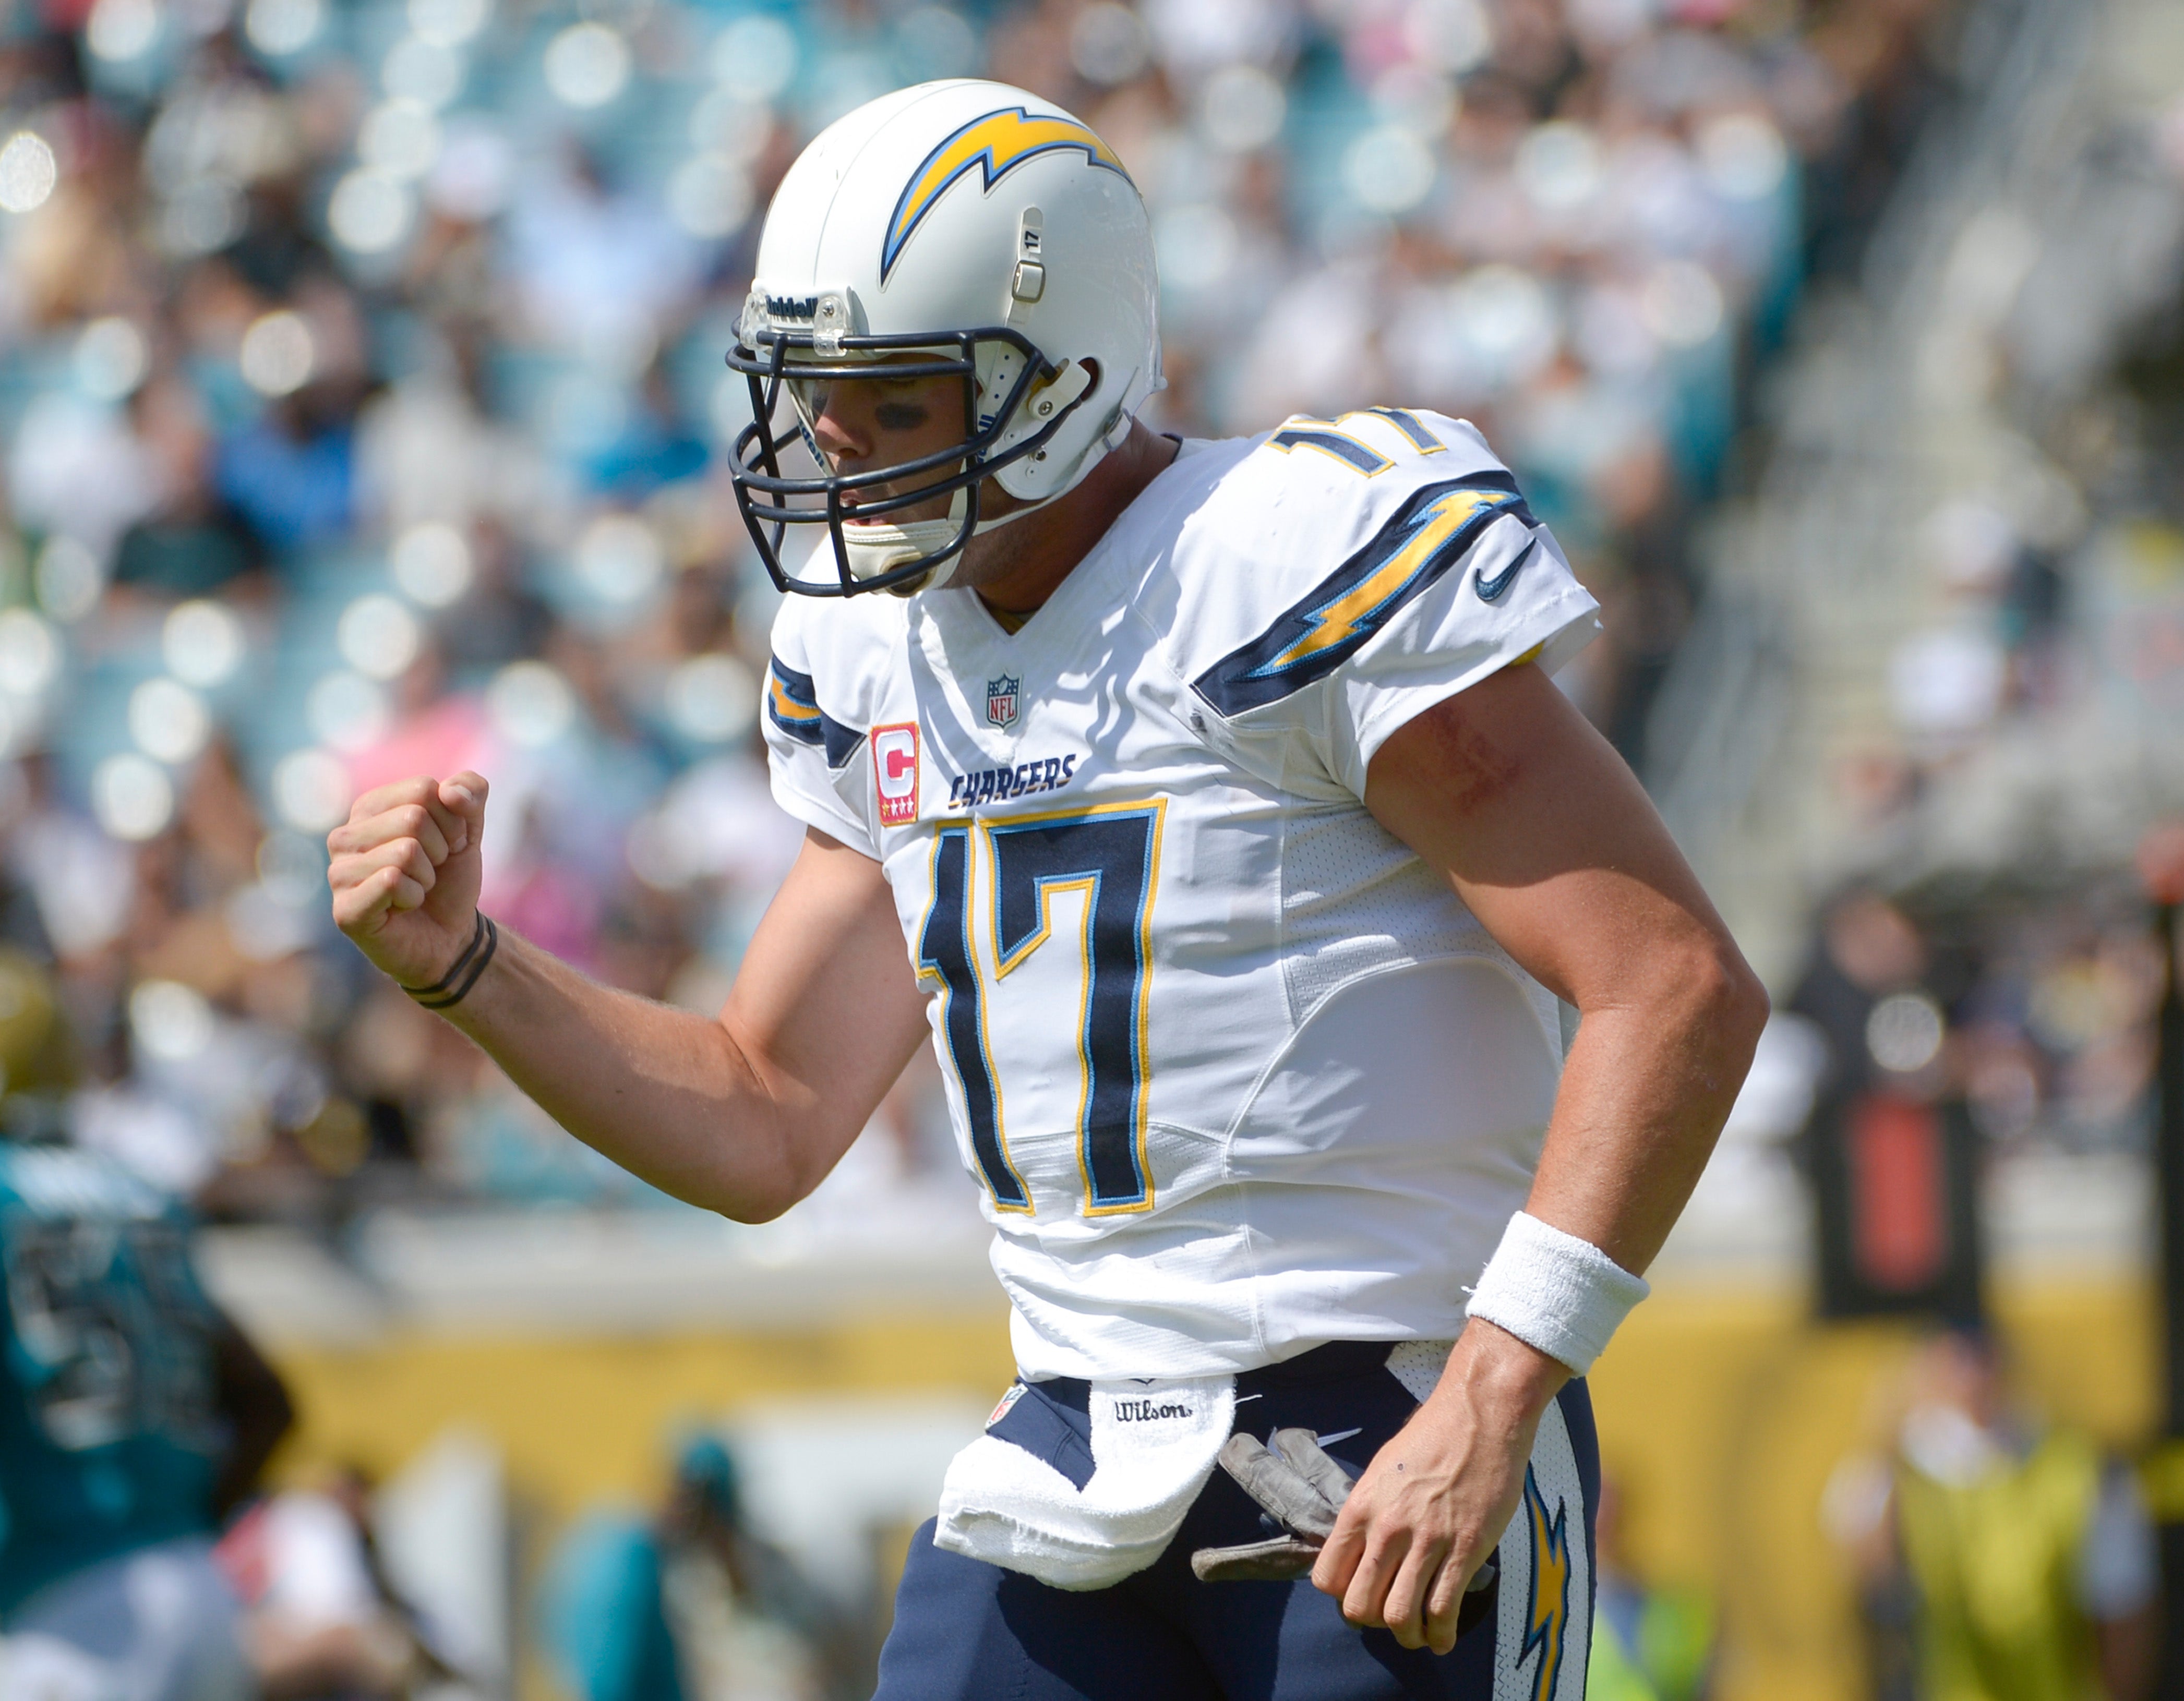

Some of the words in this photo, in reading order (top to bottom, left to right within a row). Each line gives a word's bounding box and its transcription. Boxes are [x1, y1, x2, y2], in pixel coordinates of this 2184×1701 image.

[1025, 230, 1039, 249] 17
[990, 696, 1015, 722] NFL
[875, 729, 915, 799] C
[948, 754, 1076, 810] CHARGERS
[915, 798, 1168, 1217] 17
[1114, 1400, 1187, 1422] Wilson
